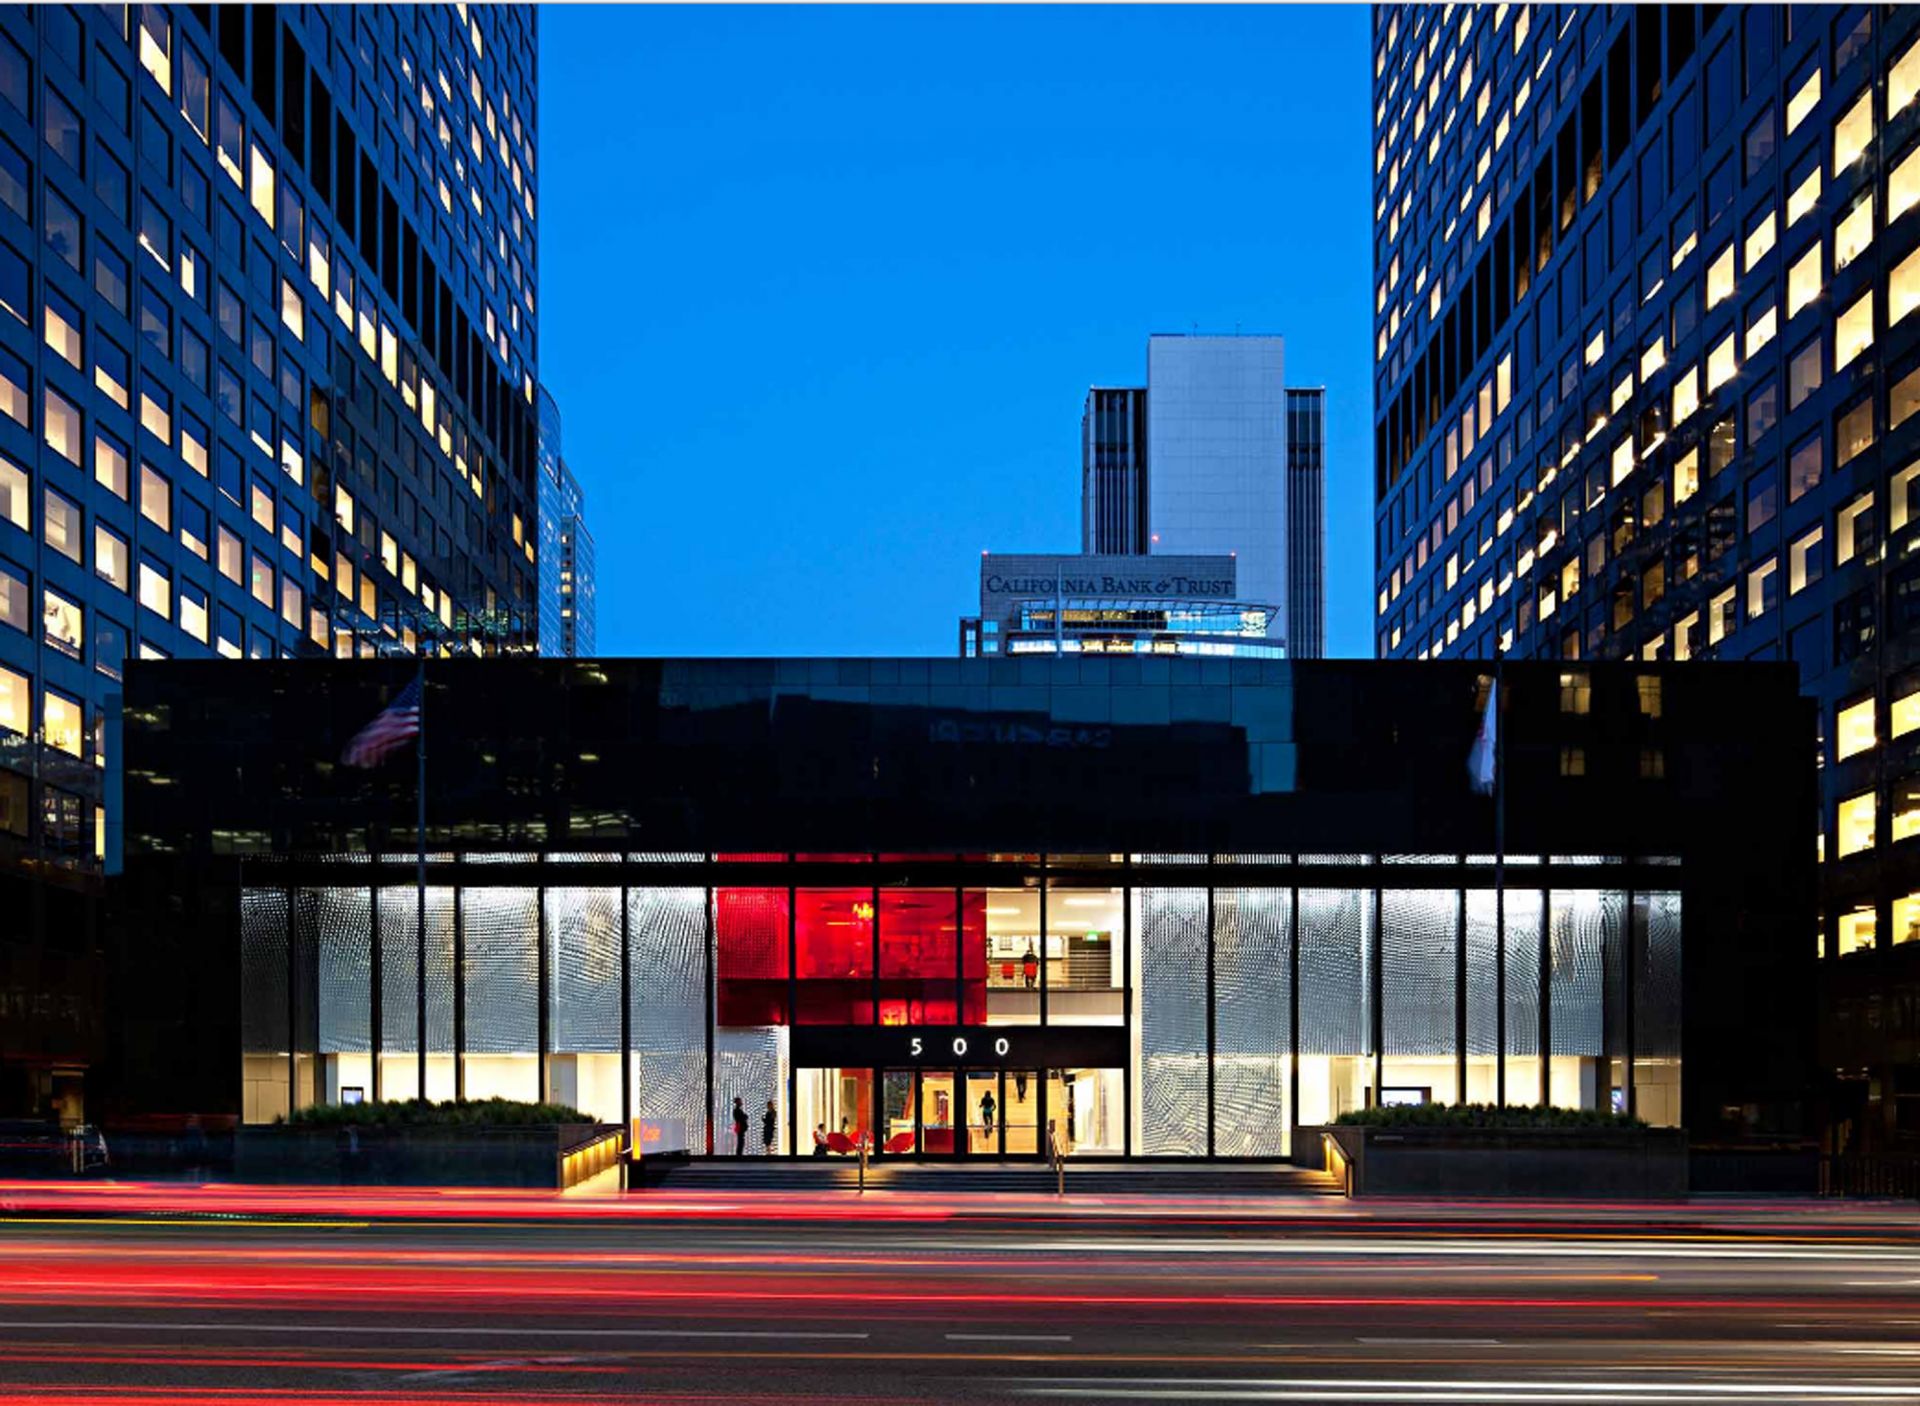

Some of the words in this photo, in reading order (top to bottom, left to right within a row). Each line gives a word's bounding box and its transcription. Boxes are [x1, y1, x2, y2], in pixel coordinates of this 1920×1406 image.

[1101, 576, 1152, 593] BANK
[1155, 579, 1170, 593] &
[1171, 576, 1233, 594] TRUST
